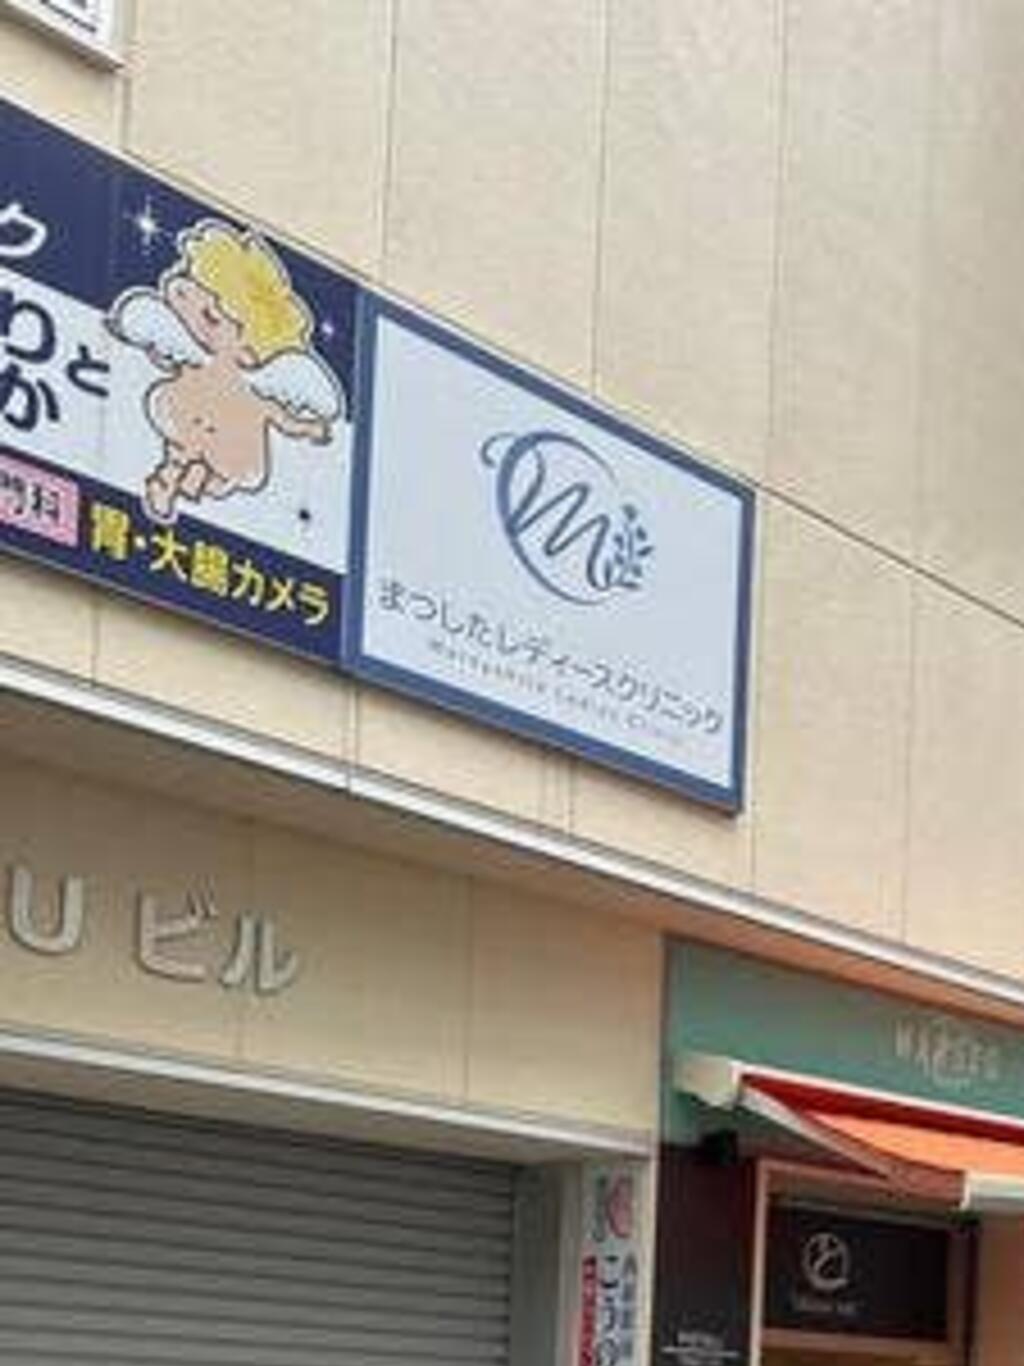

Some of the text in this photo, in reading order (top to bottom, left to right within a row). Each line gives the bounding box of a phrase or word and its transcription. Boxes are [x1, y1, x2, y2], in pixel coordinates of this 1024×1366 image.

[379, 577, 723, 734] まつしたレディースクリニック
[135, 874, 297, 997] ビル
